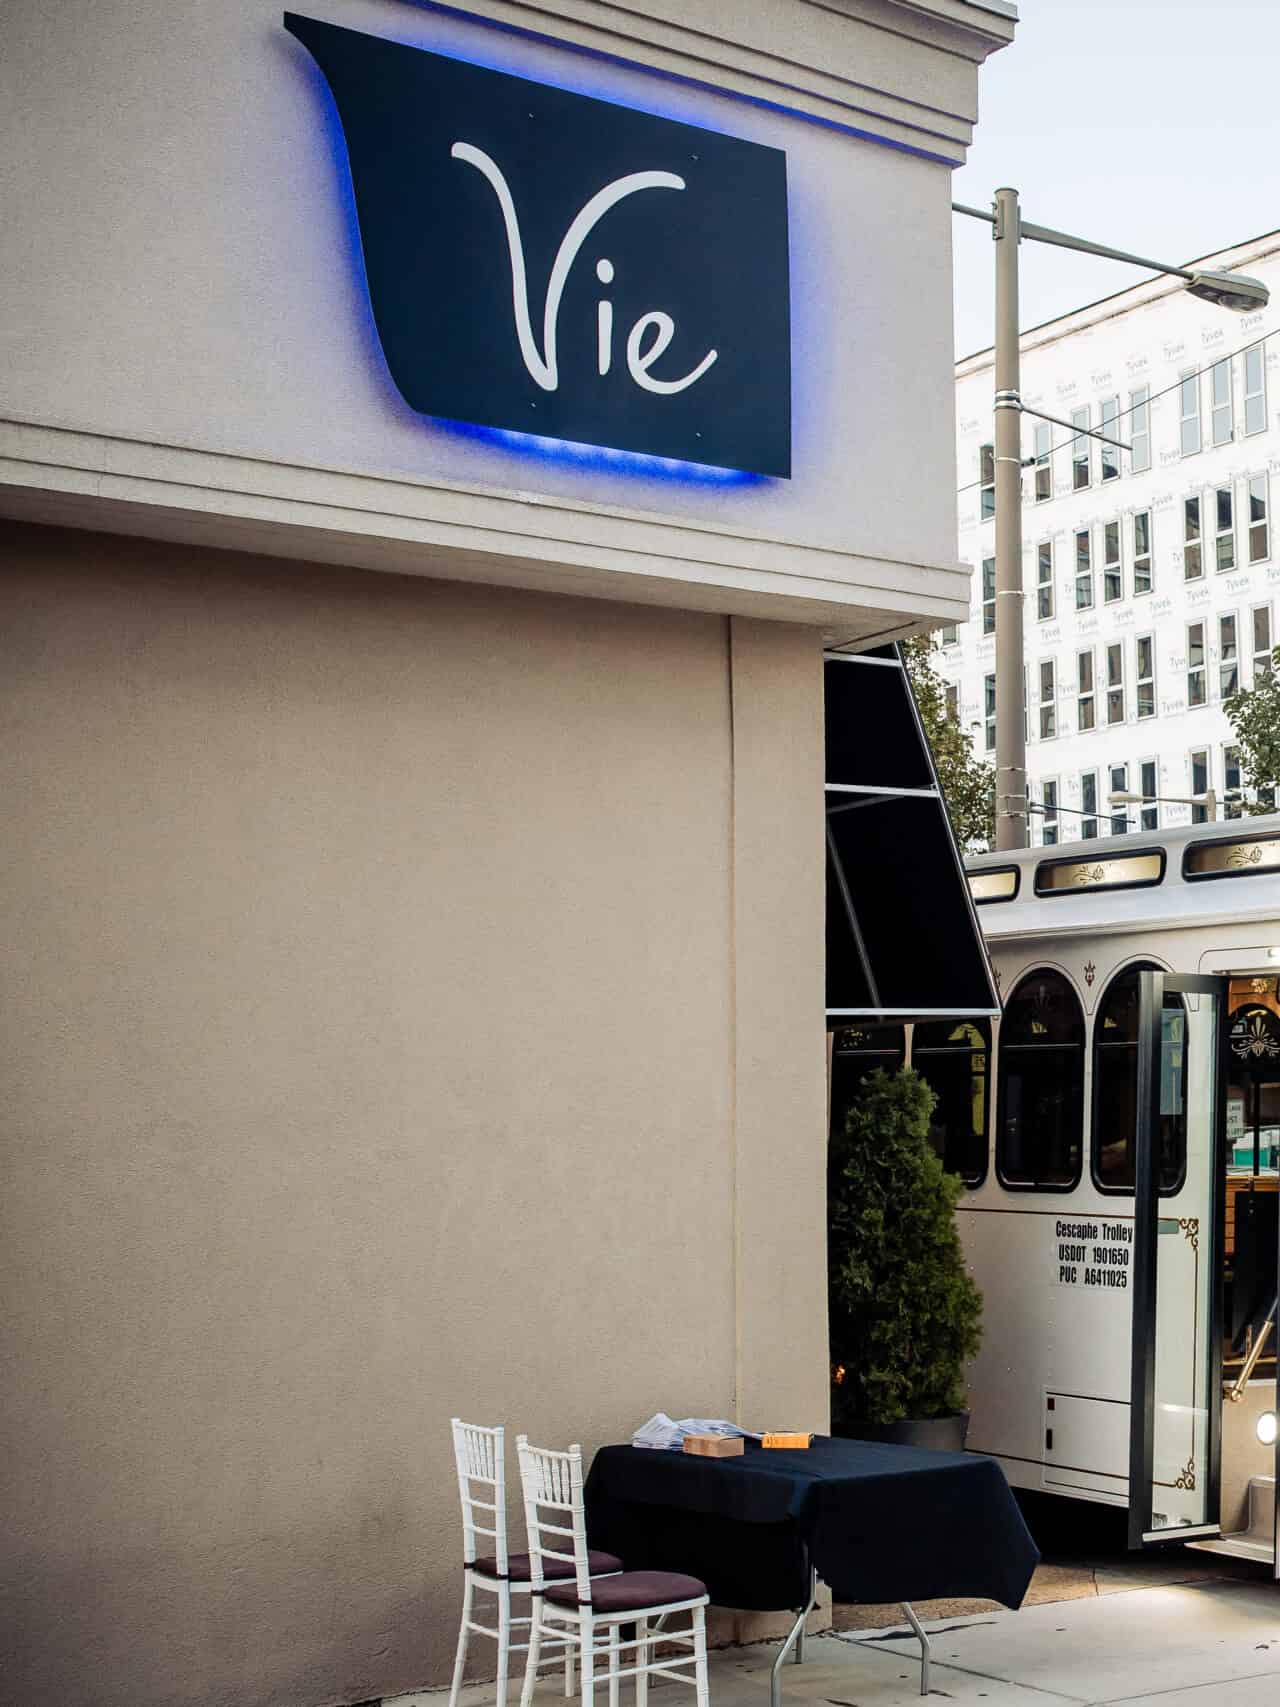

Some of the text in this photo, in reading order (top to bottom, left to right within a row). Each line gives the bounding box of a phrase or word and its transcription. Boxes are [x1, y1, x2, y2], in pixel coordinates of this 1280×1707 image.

[451, 142, 718, 394] Vie
[1056, 1220, 1133, 1243] Cescaphe Trolley
[1058, 1244, 1129, 1266] USDOT 1901650
[1059, 1265, 1127, 1288] PUC A6411025
